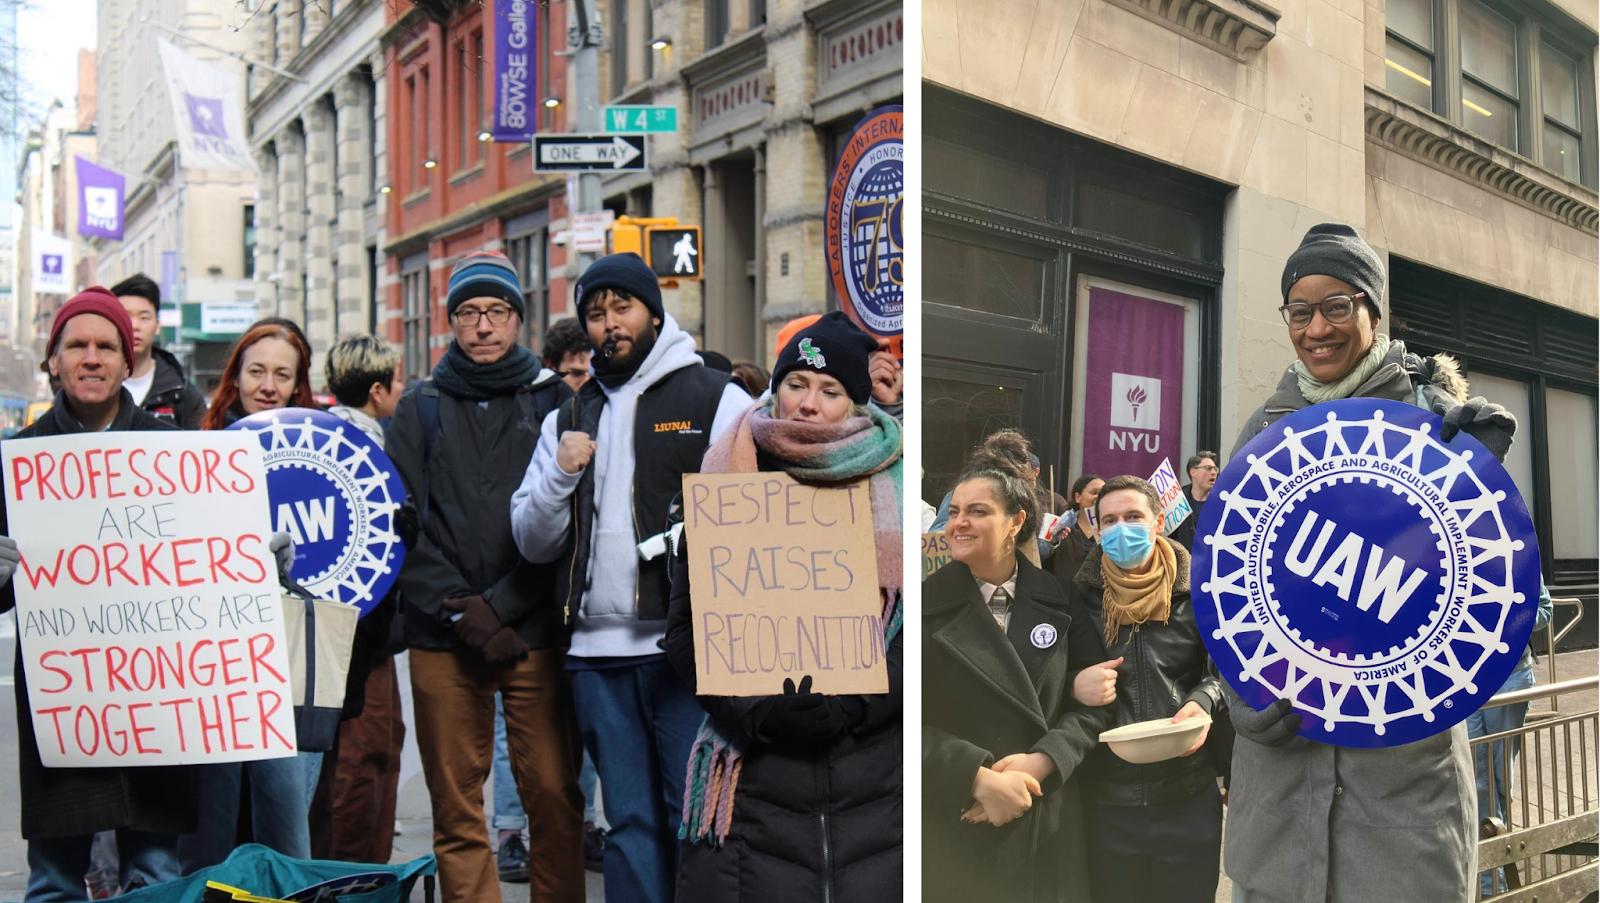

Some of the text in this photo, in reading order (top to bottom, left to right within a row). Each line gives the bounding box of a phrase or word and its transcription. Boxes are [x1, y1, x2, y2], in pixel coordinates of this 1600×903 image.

[508, 0, 528, 49] Galle
[612, 109, 667, 131] W 4 ST
[550, 146, 629, 161] ONE WAY
[830, 154, 850, 276] LABORERS'
[843, 182, 856, 251] JUSTICE
[857, 301, 886, 329] Organized
[888, 319, 903, 329] Apr
[654, 421, 691, 432] LIUNA!
[1109, 430, 1160, 453] NYU
[12, 448, 255, 501] PROFESSORS
[1149, 461, 1174, 495] ON
[97, 502, 177, 541] ARE
[262, 450, 366, 581] AGRICULTURAL IMPLEMENT WORKERS OF AMERICA
[277, 496, 335, 545] AW
[691, 479, 861, 528] RESPECT
[18, 534, 267, 591] WORKERS
[709, 546, 854, 598] RAISES
[1248, 458, 1468, 680] UNITED AUTOMOBILE, AEROSPACE AND AGRICULTURAL IMPLEMENT WORKERS OF AMERICA
[1284, 509, 1429, 624] UAW
[24, 593, 274, 638] AND WORKERS ARE
[39, 633, 287, 693] STRONGER
[703, 612, 886, 675] RECOGNITION
[36, 690, 294, 756] TOGETHER
